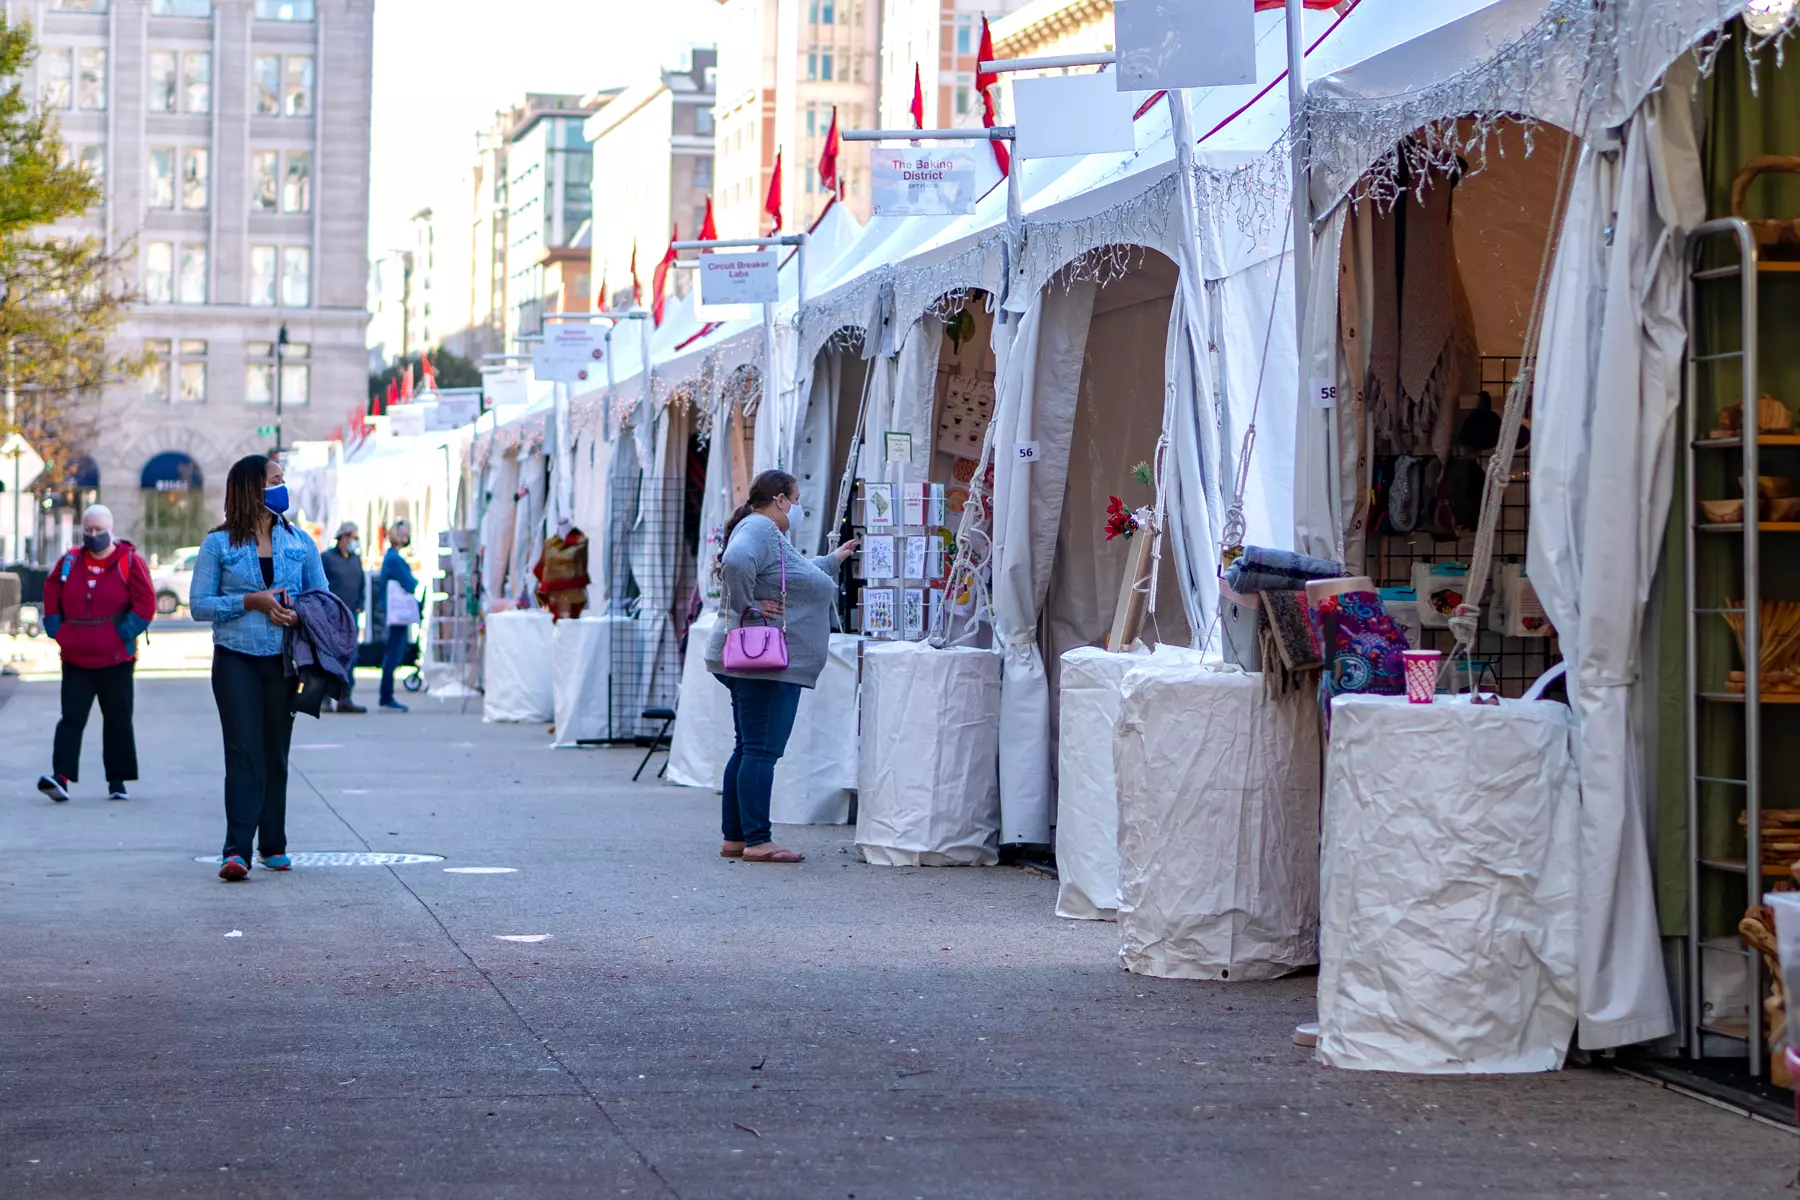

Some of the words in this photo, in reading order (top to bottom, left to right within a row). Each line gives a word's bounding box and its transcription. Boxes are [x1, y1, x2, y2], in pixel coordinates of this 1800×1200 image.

[892, 160, 912, 169] The
[916, 160, 953, 170] Baking
[903, 171, 943, 180] District
[737, 261, 769, 269] Breaker
[1321, 386, 1336, 399] 58
[1019, 447, 1033, 458] 56
